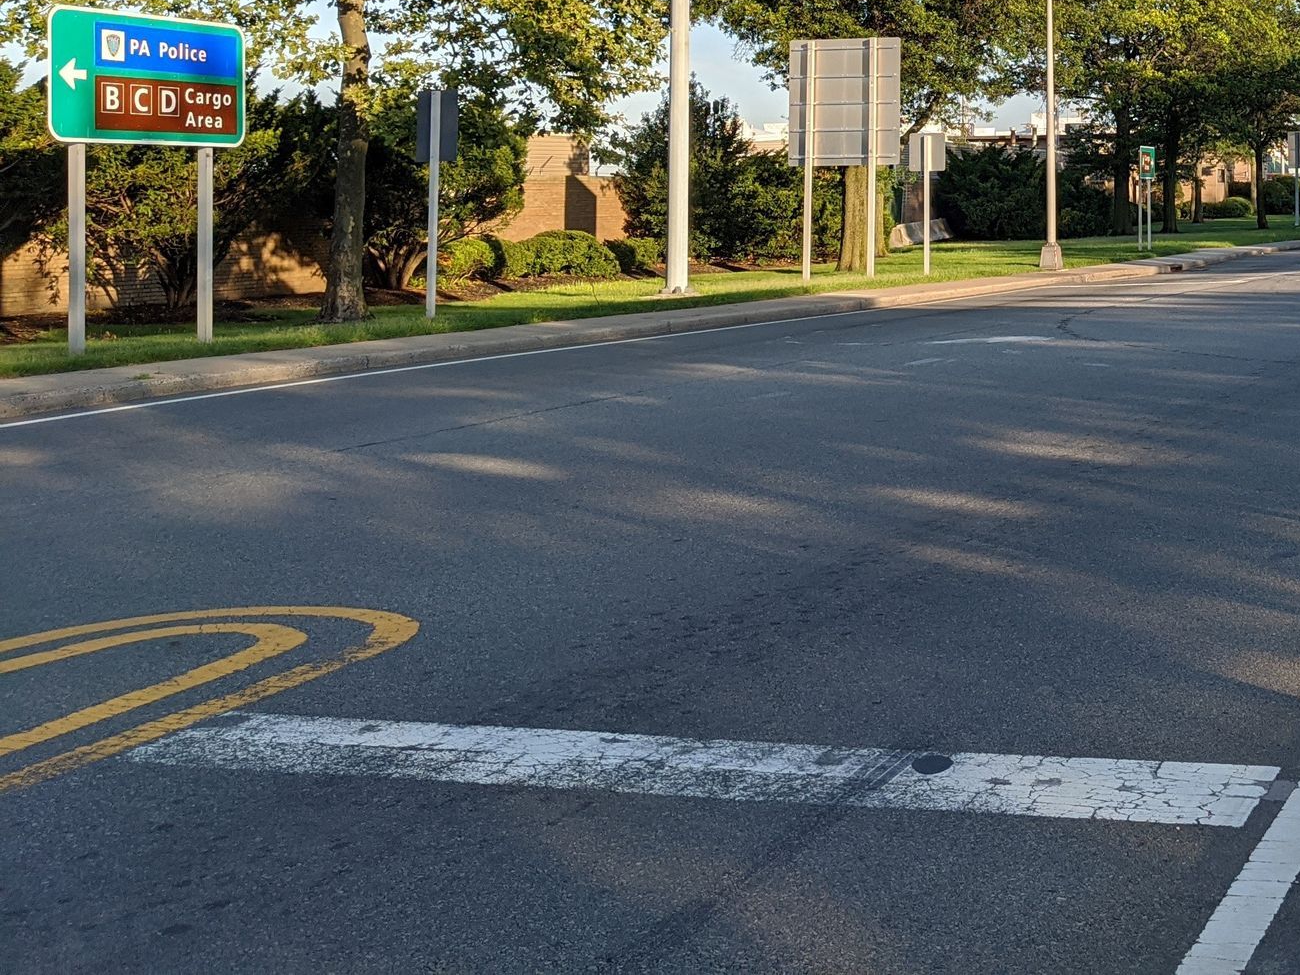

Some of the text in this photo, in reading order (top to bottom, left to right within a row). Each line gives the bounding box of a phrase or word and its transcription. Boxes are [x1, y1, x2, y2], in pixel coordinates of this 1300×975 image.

[130, 38, 207, 62] PA Police
[105, 85, 232, 113] B C D Cargo
[185, 111, 223, 129] Area
